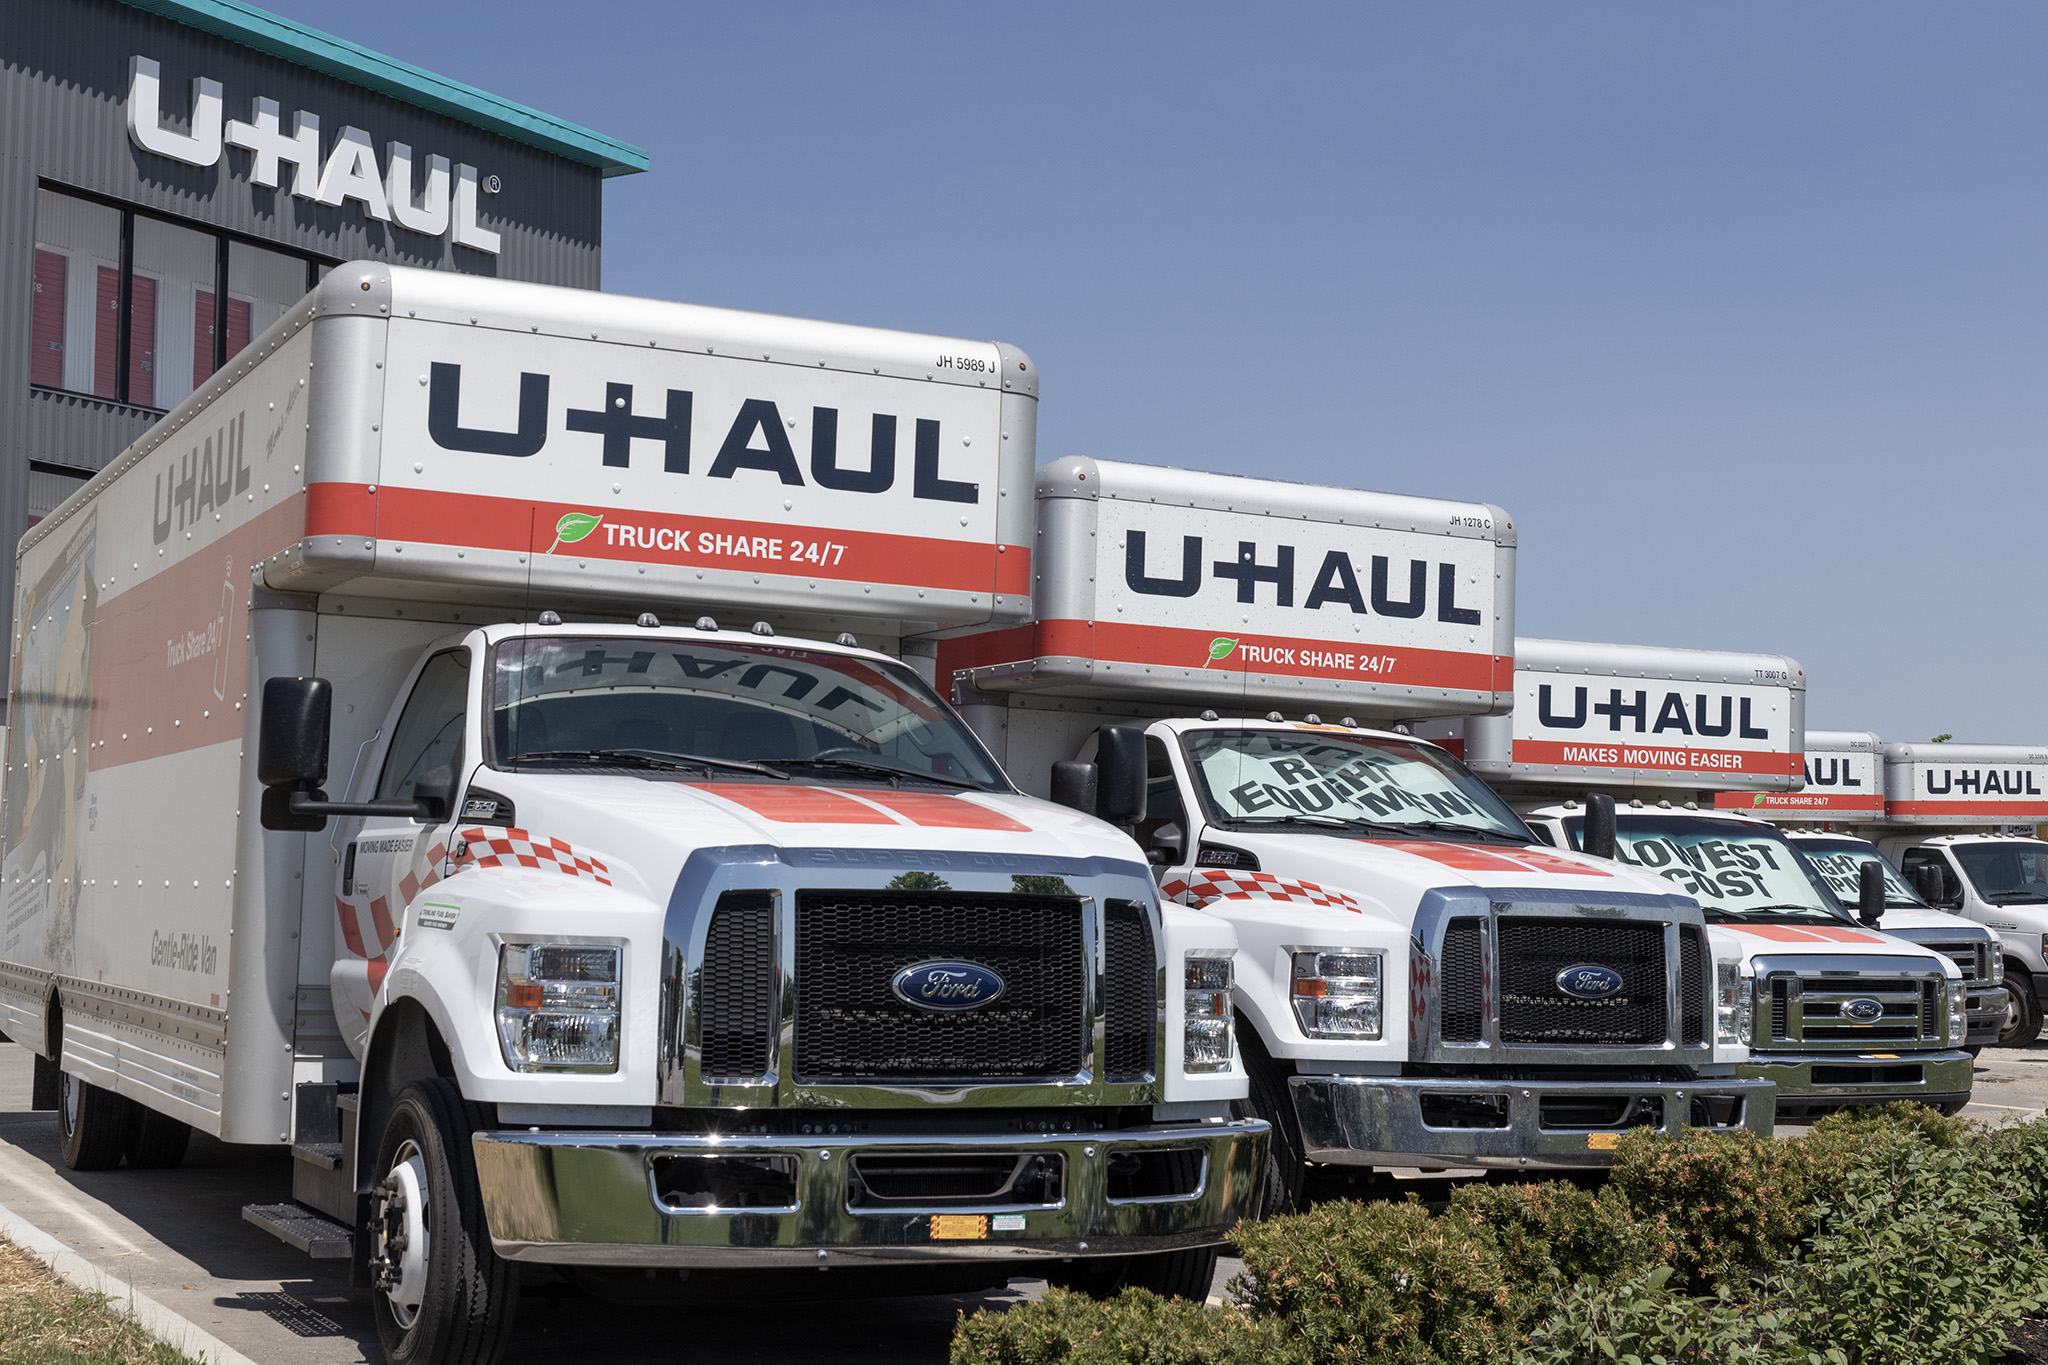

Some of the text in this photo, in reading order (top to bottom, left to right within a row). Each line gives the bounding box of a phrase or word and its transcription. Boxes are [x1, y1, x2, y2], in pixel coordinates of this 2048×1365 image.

[936, 355, 995, 374] JH 5989 J
[1449, 515, 1491, 529] JH 1278 C
[602, 523, 845, 566] TRUCK SHARE 24/7
[167, 611, 224, 668] Truck Share 24/7
[1239, 644, 1396, 674] TRUCK SHARE 24/7
[1754, 669, 1763, 678] TT
[1764, 670, 1780, 679] 3007
[1563, 747, 1743, 769] MAKES MOVING EASIER
[1765, 797, 1829, 806] TRUCK SHARE 24/7
[359, 839, 414, 853] MOVING MADE EASIER
[1615, 838, 1781, 872] LOWEST
[811, 849, 953, 867] SUPER
[1806, 855, 1860, 875] IGHT
[1660, 868, 1773, 899] COST
[151, 929, 217, 976] Gentle-Ride Van
[921, 970, 982, 998] Ford
[1575, 971, 1611, 991] Ford
[1856, 1004, 1875, 1015] Ford
